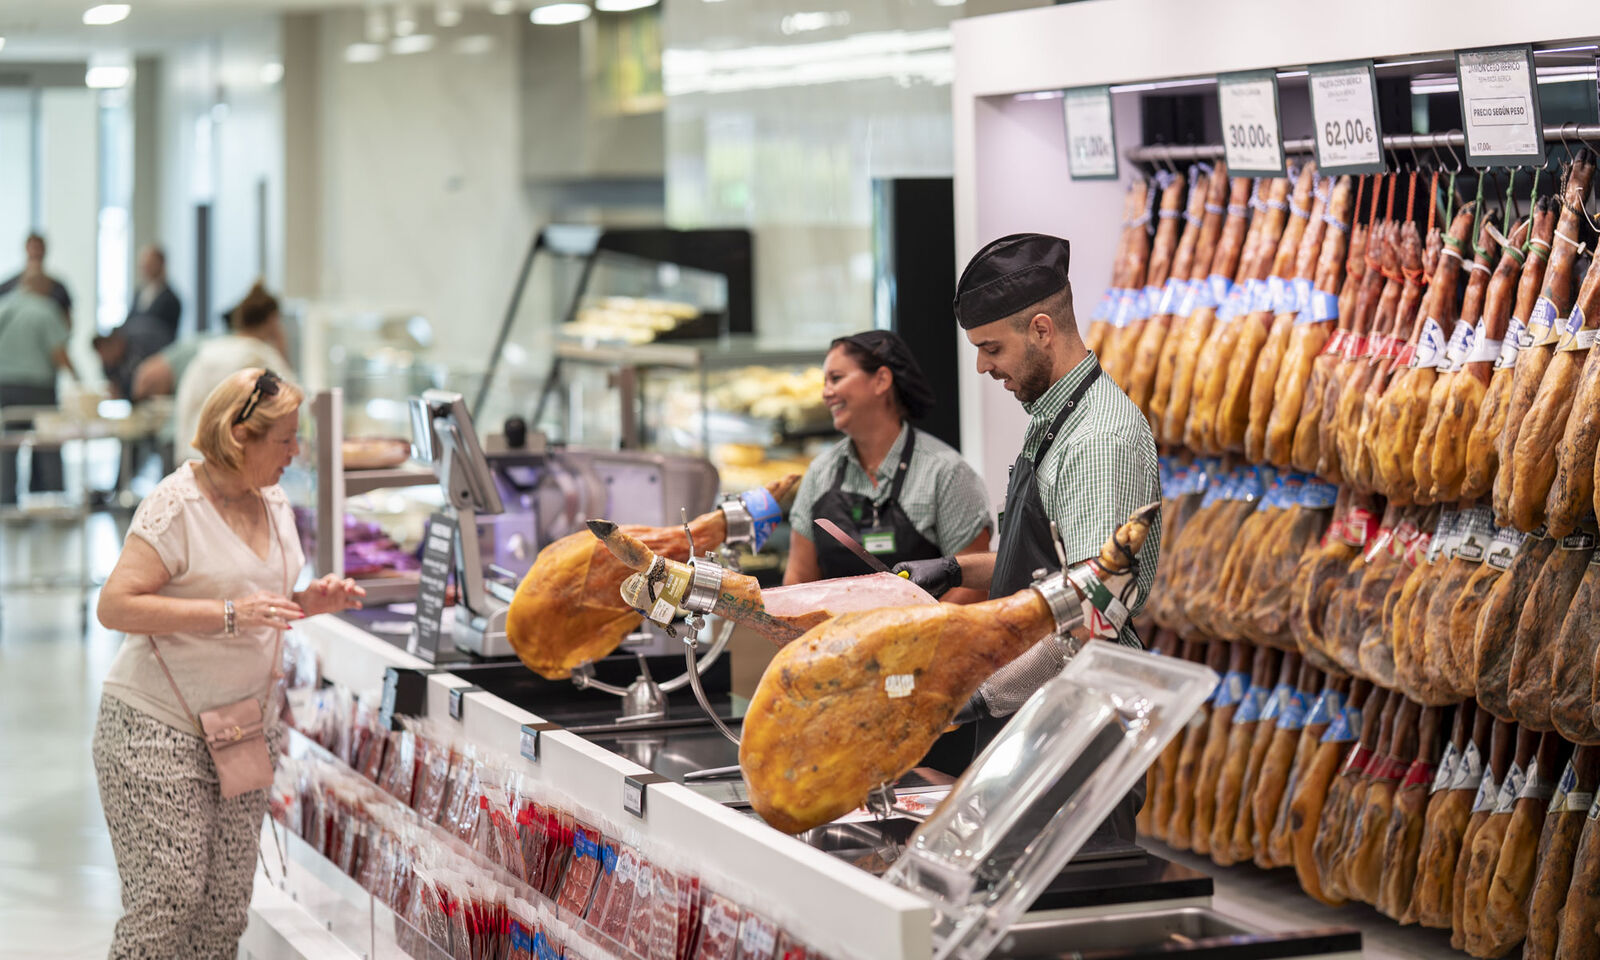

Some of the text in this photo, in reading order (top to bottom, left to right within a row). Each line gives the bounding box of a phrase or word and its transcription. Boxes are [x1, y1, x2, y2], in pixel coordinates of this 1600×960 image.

[1473, 105, 1525, 117] PRECIO SEGÚN PESO
[1230, 124, 1272, 151] 30,00€
[1325, 118, 1373, 149] 62,00€
